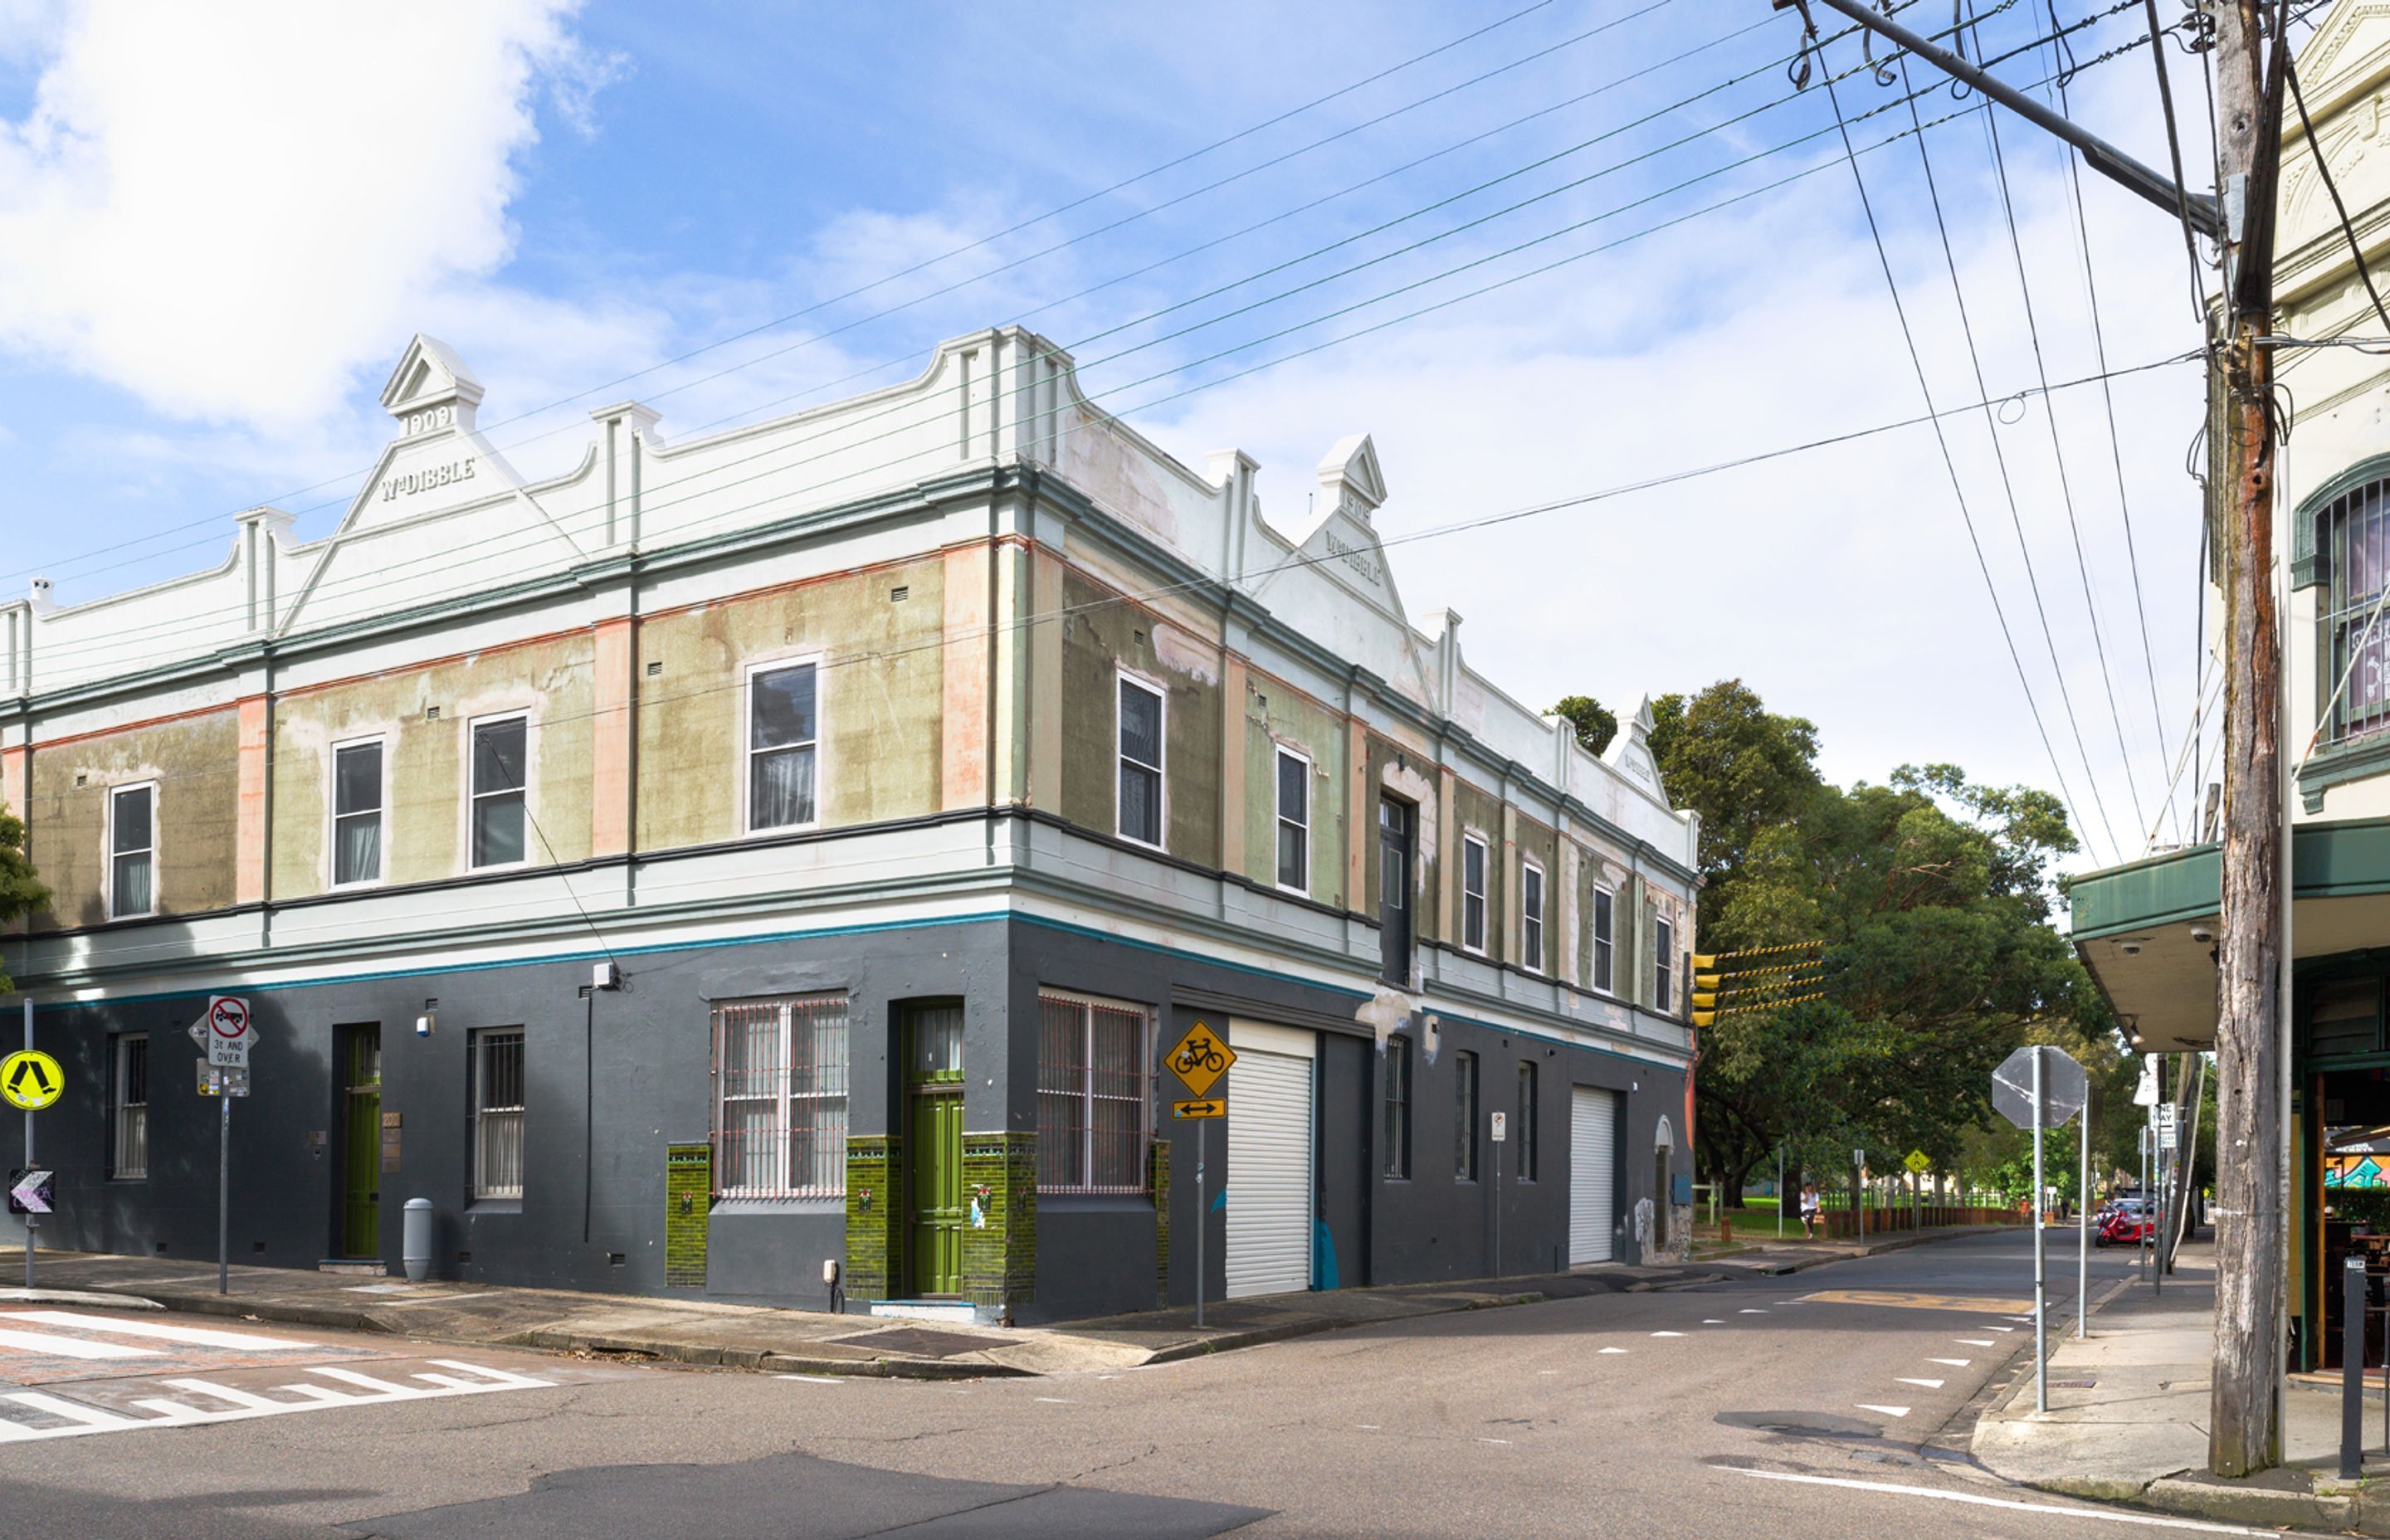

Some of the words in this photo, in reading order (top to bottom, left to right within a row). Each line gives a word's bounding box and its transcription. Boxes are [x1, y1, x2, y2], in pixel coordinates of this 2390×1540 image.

[403, 406, 451, 436] 1909
[406, 456, 476, 495] DIBBLE
[227, 1041, 243, 1051] AND
[217, 1053, 241, 1063] OVER
